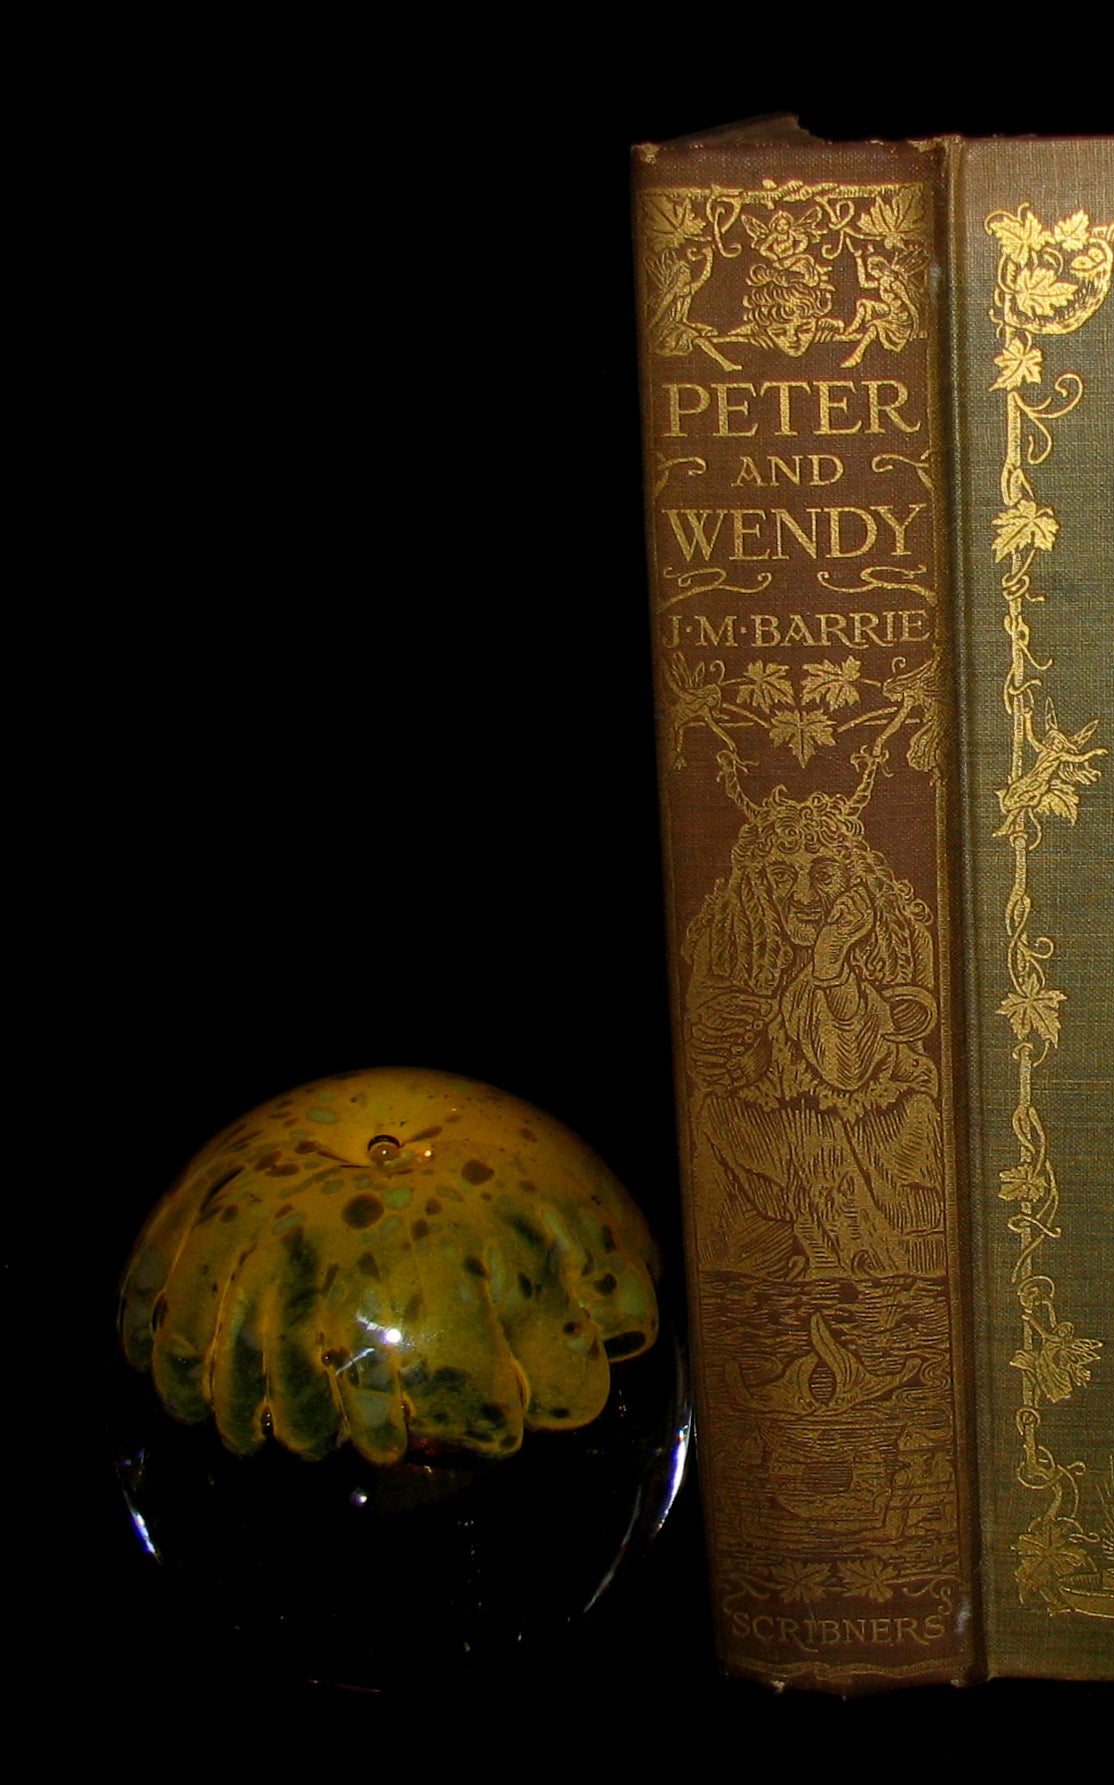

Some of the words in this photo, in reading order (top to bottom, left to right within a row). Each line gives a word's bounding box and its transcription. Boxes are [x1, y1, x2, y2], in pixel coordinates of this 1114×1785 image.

[661, 380, 921, 437] PETER
[731, 454, 845, 487] AND
[661, 503, 927, 562] WENDY
[732, 1612, 946, 1652] SCRIBNERS
